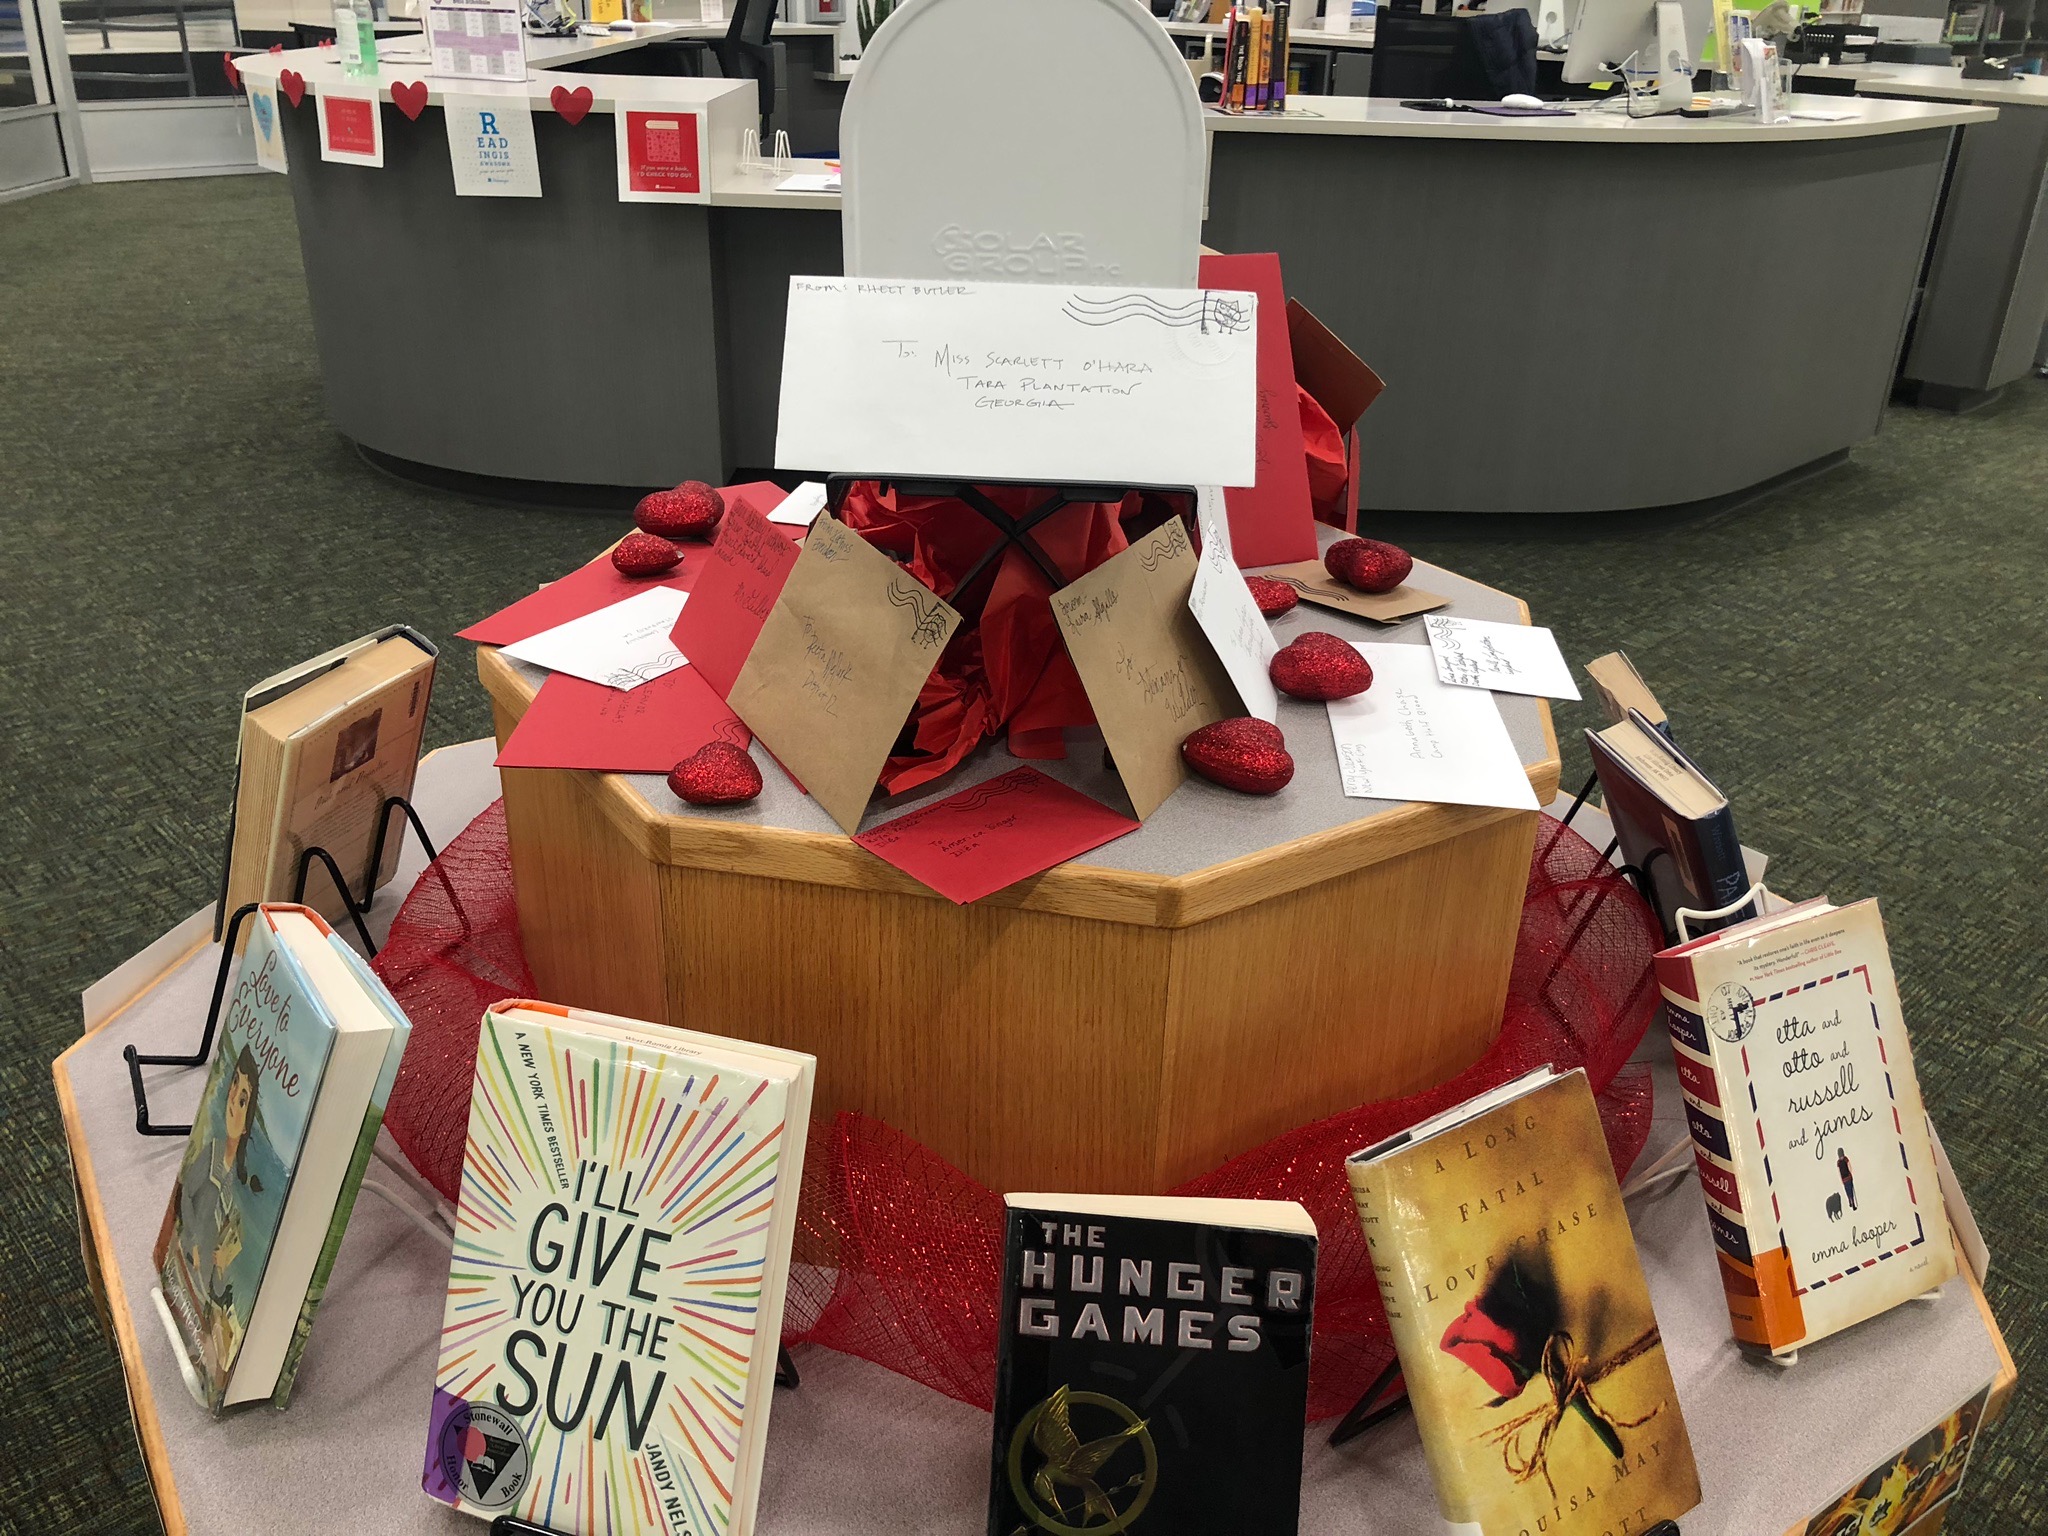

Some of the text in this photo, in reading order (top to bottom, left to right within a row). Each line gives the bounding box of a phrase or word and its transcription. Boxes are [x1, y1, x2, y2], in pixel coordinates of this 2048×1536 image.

[479, 111, 500, 135] R
[986, 351, 1064, 370] SCARLETT
[1743, 955, 1753, 964] book
[1753, 953, 1762, 961] that
[1762, 949, 1779, 958] restores
[1789, 942, 1799, 950] faith
[228, 980, 301, 1098] Everyone
[1776, 1016, 1816, 1044] etta
[1821, 1009, 1842, 1030] and
[1782, 1041, 1850, 1078] otto and
[515, 1032, 570, 1190] A NEW YORK TIMES BESTSELLER
[1788, 1062, 1860, 1114] russell
[1434, 1115, 1539, 1175] A LONG
[1788, 1105, 1873, 1161] and james
[573, 1158, 641, 1219] I'LL
[1458, 1171, 1545, 1224] FATAL
[1700, 1168, 1733, 1195] ussell
[1041, 1221, 1107, 1249] THE
[1514, 1203, 1600, 1251] CHASE
[1811, 1220, 1897, 1264] emma hooper
[529, 1202, 673, 1304] GIVE
[1021, 1249, 1303, 1311] HUNGER
[511, 1274, 676, 1362] YOU THE
[1018, 1298, 1262, 1352] GAMES
[495, 1329, 668, 1453] SUN
[463, 1410, 514, 1436] Stonewall
[446, 1454, 523, 1498] Honor Book
[645, 1442, 676, 1491] JANDY
[1612, 1440, 1665, 1484] MAY
